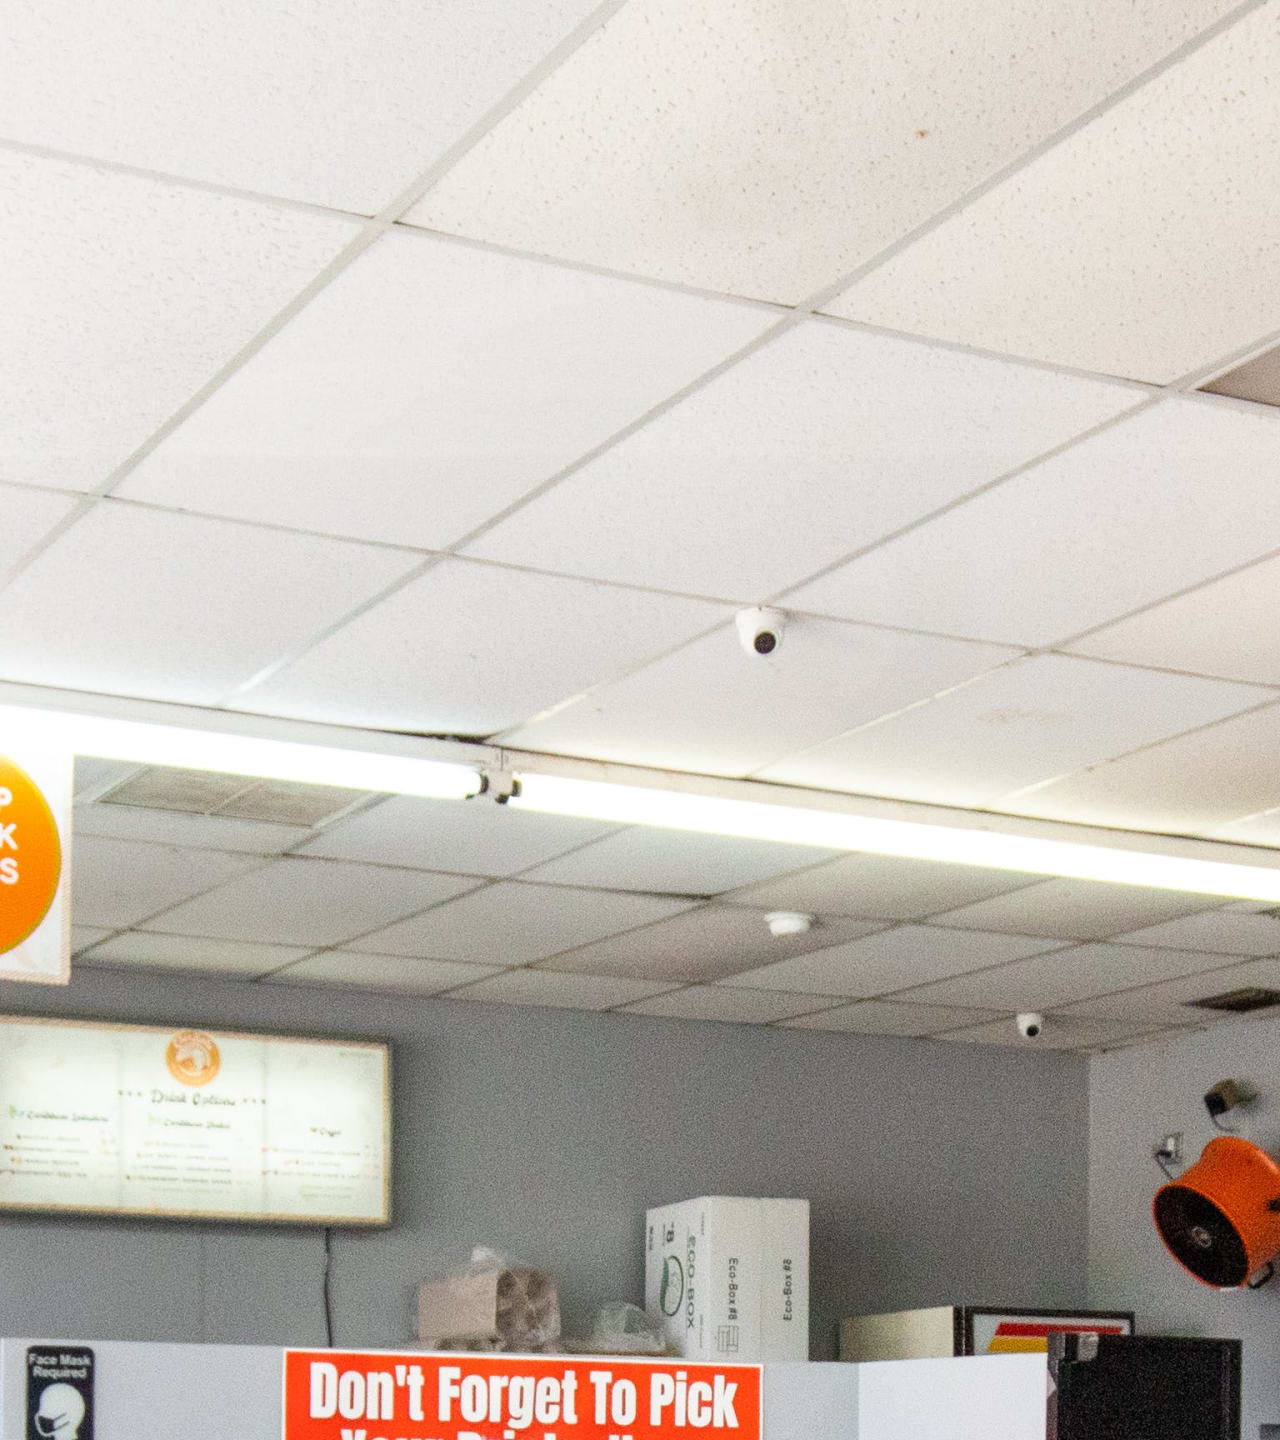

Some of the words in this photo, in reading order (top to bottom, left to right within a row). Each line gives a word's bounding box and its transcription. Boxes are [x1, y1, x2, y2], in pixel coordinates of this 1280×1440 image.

[686, 1235, 696, 1329] ECO-BOX
[728, 1257, 738, 1304] Eco-Box
[783, 1274, 793, 1321] Eco-Box
[728, 1308, 738, 1320] #8
[29, 1353, 58, 1366] Face
[60, 1354, 92, 1366] Mask
[33, 1365, 87, 1380] Required
[309, 1361, 425, 1421] Don't
[438, 1365, 578, 1429] Forget
[590, 1370, 636, 1426] To
[650, 1371, 740, 1429] Pick
